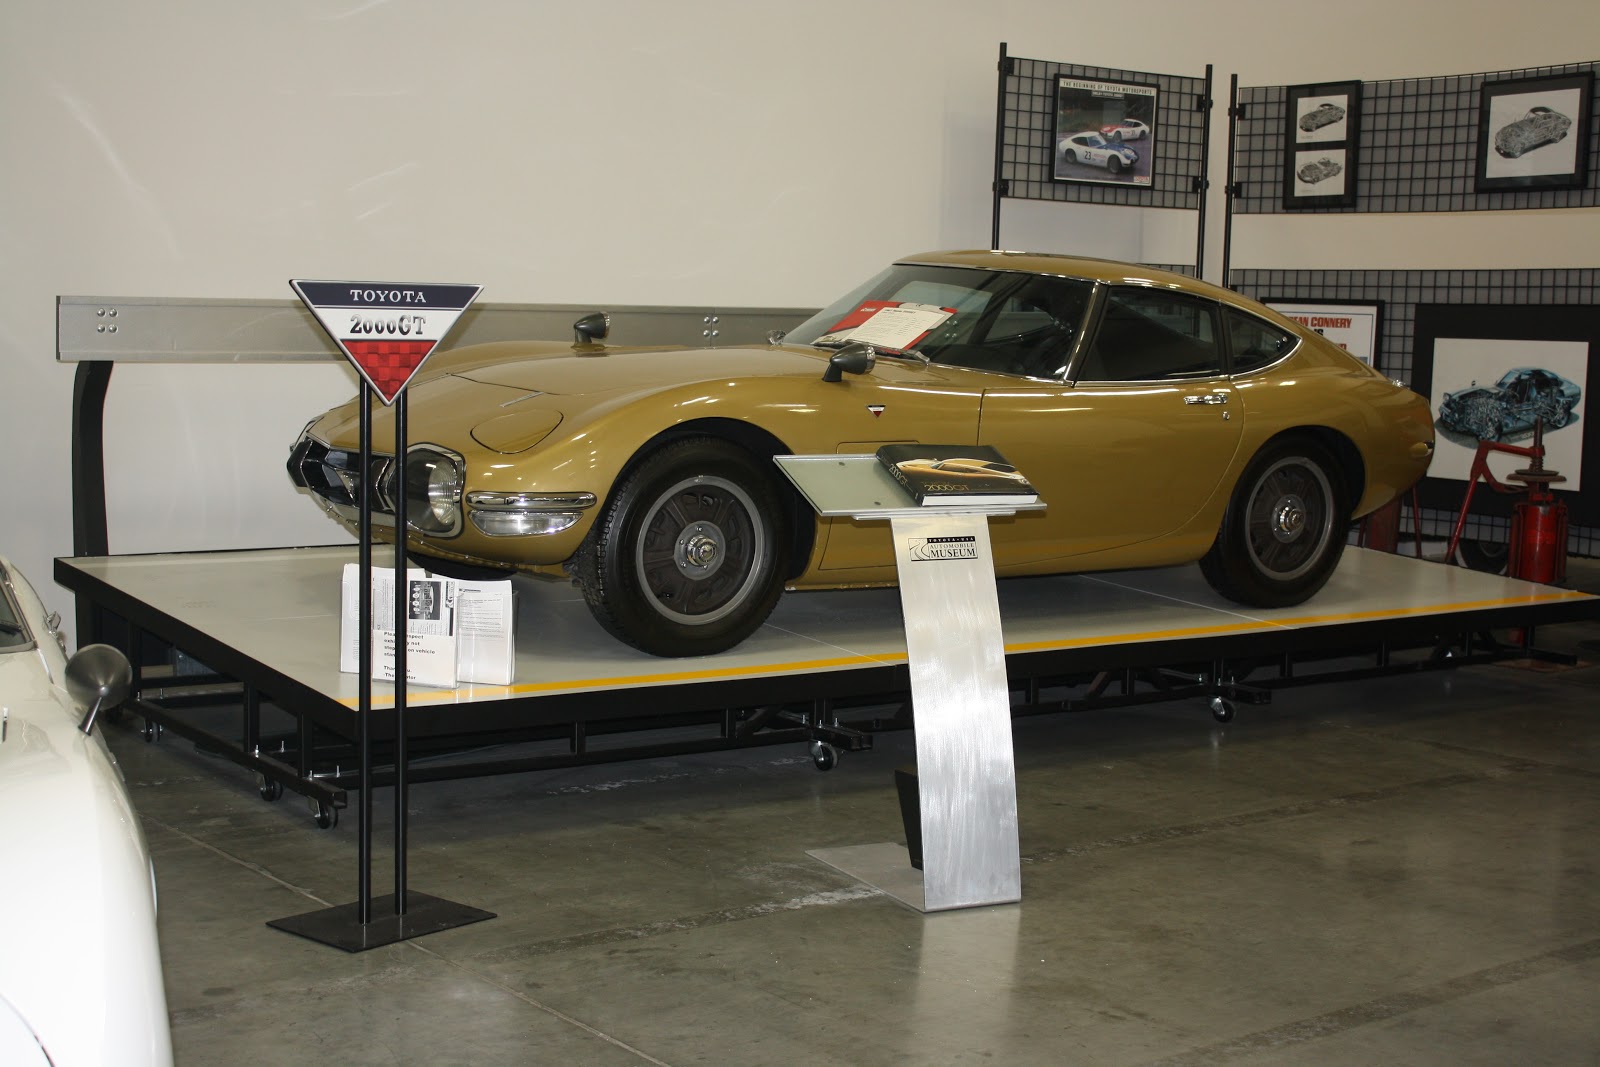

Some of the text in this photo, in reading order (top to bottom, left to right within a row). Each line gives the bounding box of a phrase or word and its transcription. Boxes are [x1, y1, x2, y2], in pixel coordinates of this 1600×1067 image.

[1073, 82, 1096, 90] BEGINNING
[1122, 87, 1152, 95] MOTORSPORTS
[1085, 150, 1091, 160] 23
[350, 289, 426, 303] TOYOTA
[350, 314, 426, 336] 2000GT
[1310, 316, 1352, 328] CONNERY
[930, 548, 976, 558] MUSEUM
